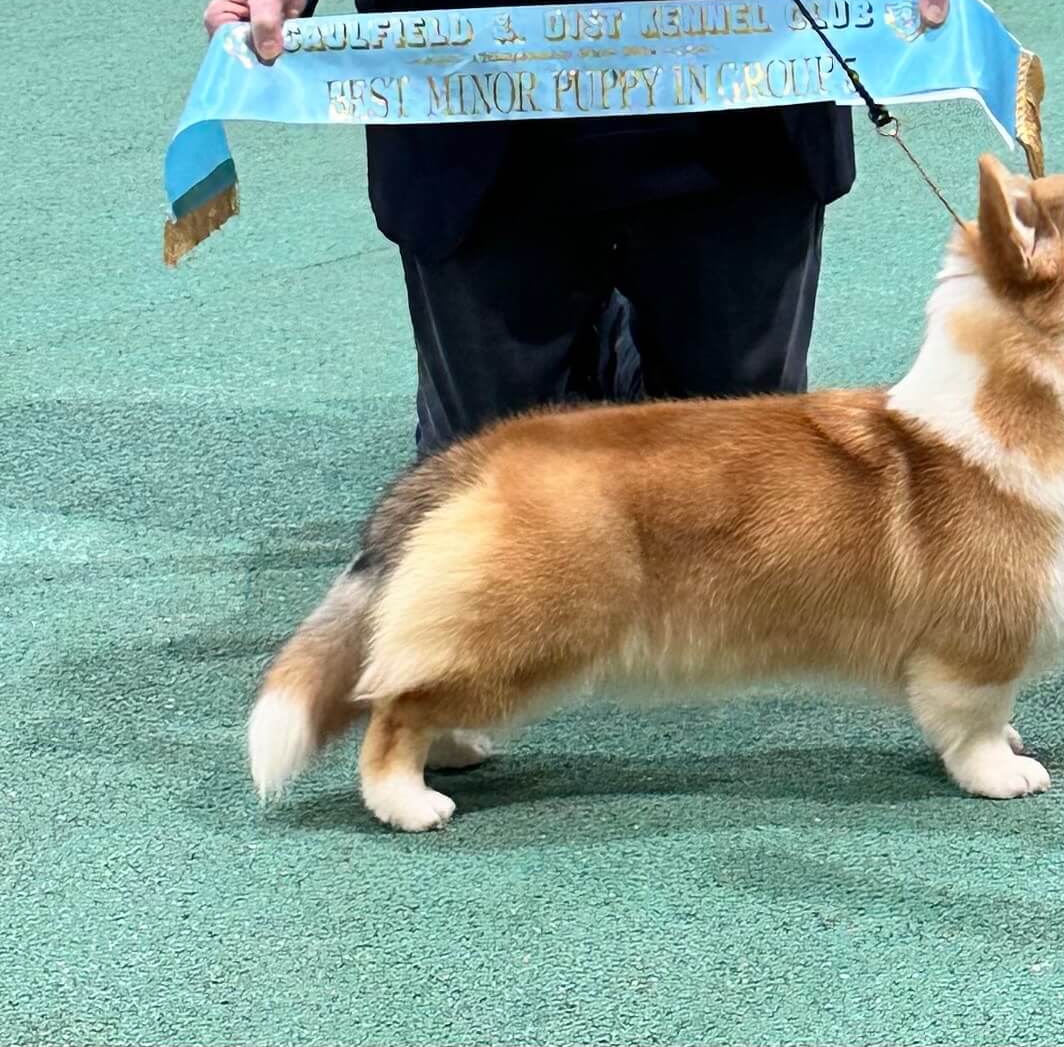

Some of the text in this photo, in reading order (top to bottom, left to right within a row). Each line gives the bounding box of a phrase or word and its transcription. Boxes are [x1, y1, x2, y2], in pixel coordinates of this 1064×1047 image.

[283, 15, 475, 53] CAULFIELD
[544, 7, 624, 42] DIST
[326, 73, 410, 120] BEST
[425, 67, 542, 117] MINOR
[551, 64, 663, 112] PUPPY
[673, 63, 709, 106] IN
[715, 55, 835, 102] GROUP
